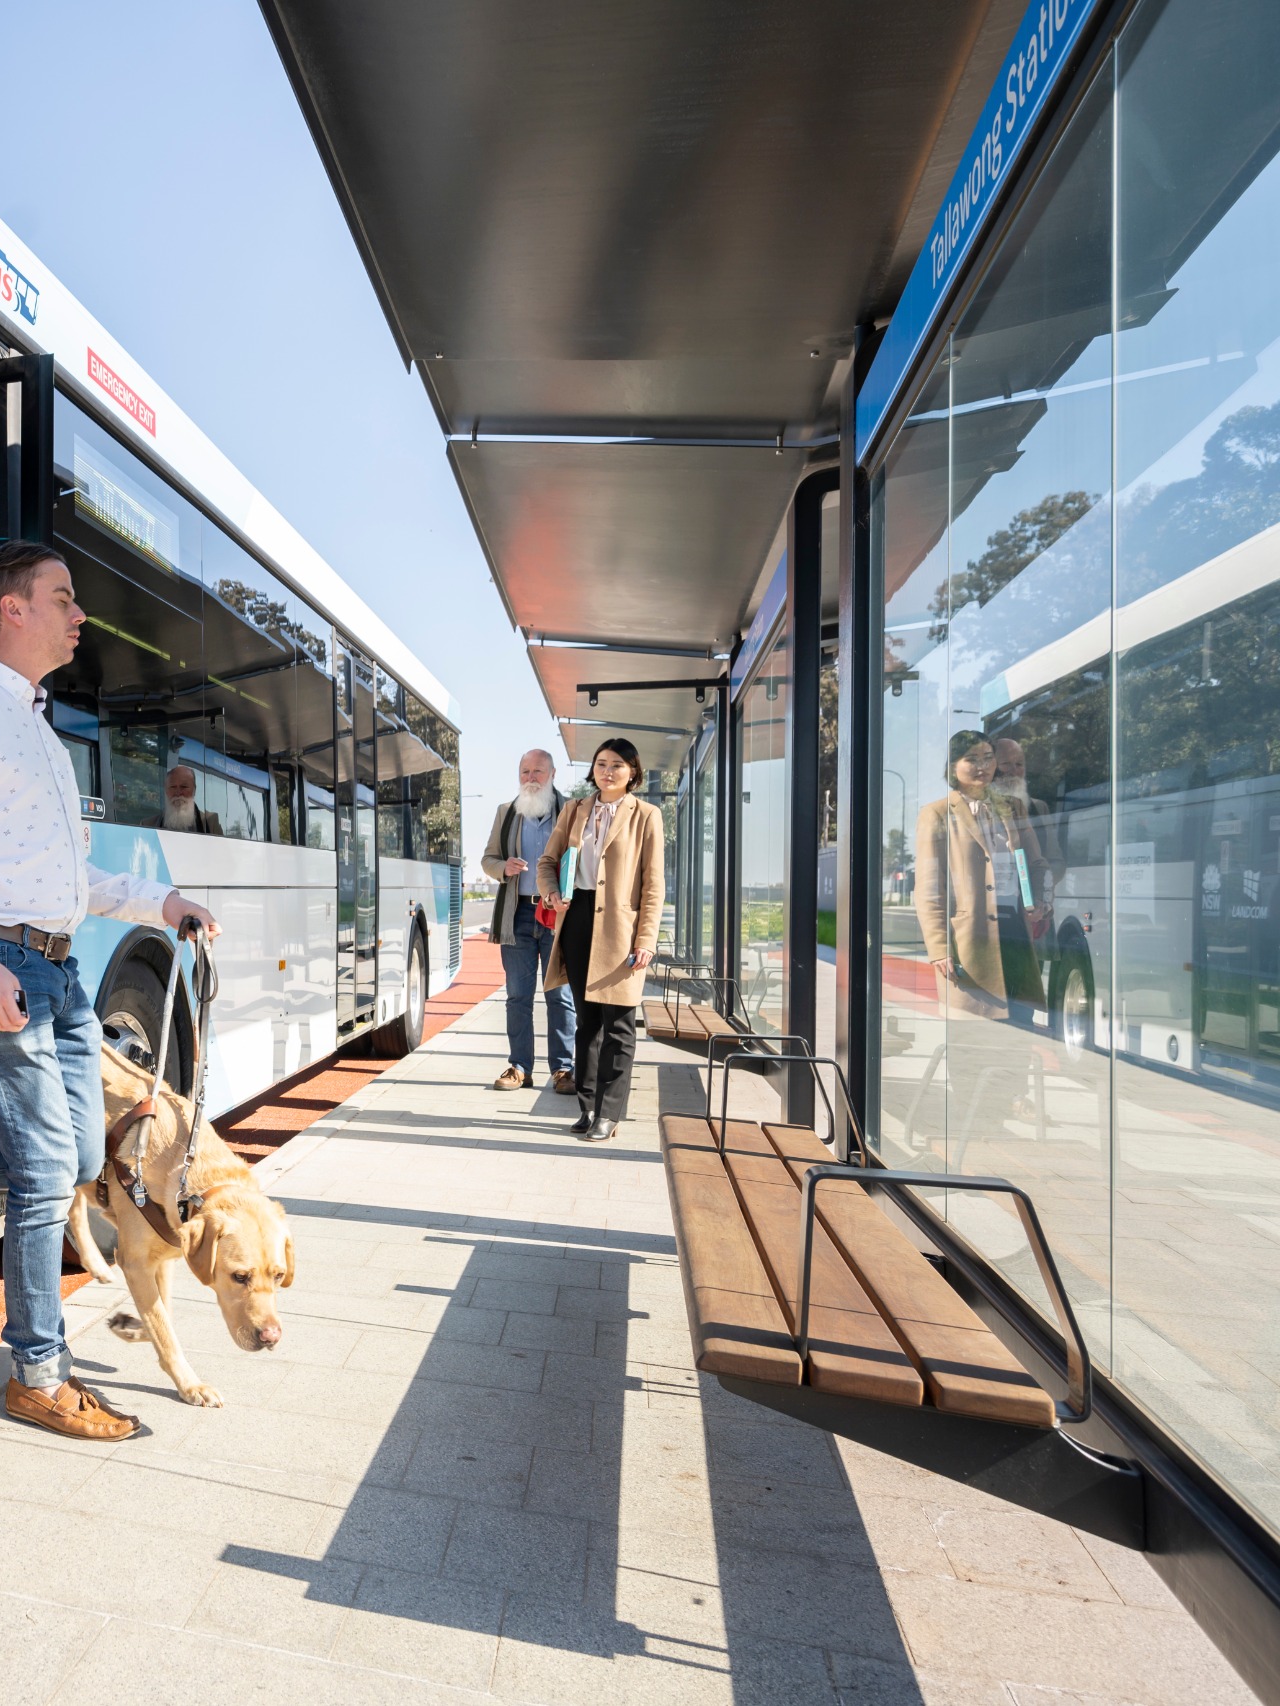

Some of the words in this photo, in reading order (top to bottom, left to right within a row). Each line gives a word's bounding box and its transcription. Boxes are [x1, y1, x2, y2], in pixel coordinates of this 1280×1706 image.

[931, 103, 1003, 290] Tallawong
[1006, 0, 1075, 133] Statio
[90, 355, 138, 415] EMERGENCY
[139, 402, 154, 430] EXIT
[1231, 905, 1268, 919] LANDCOM
